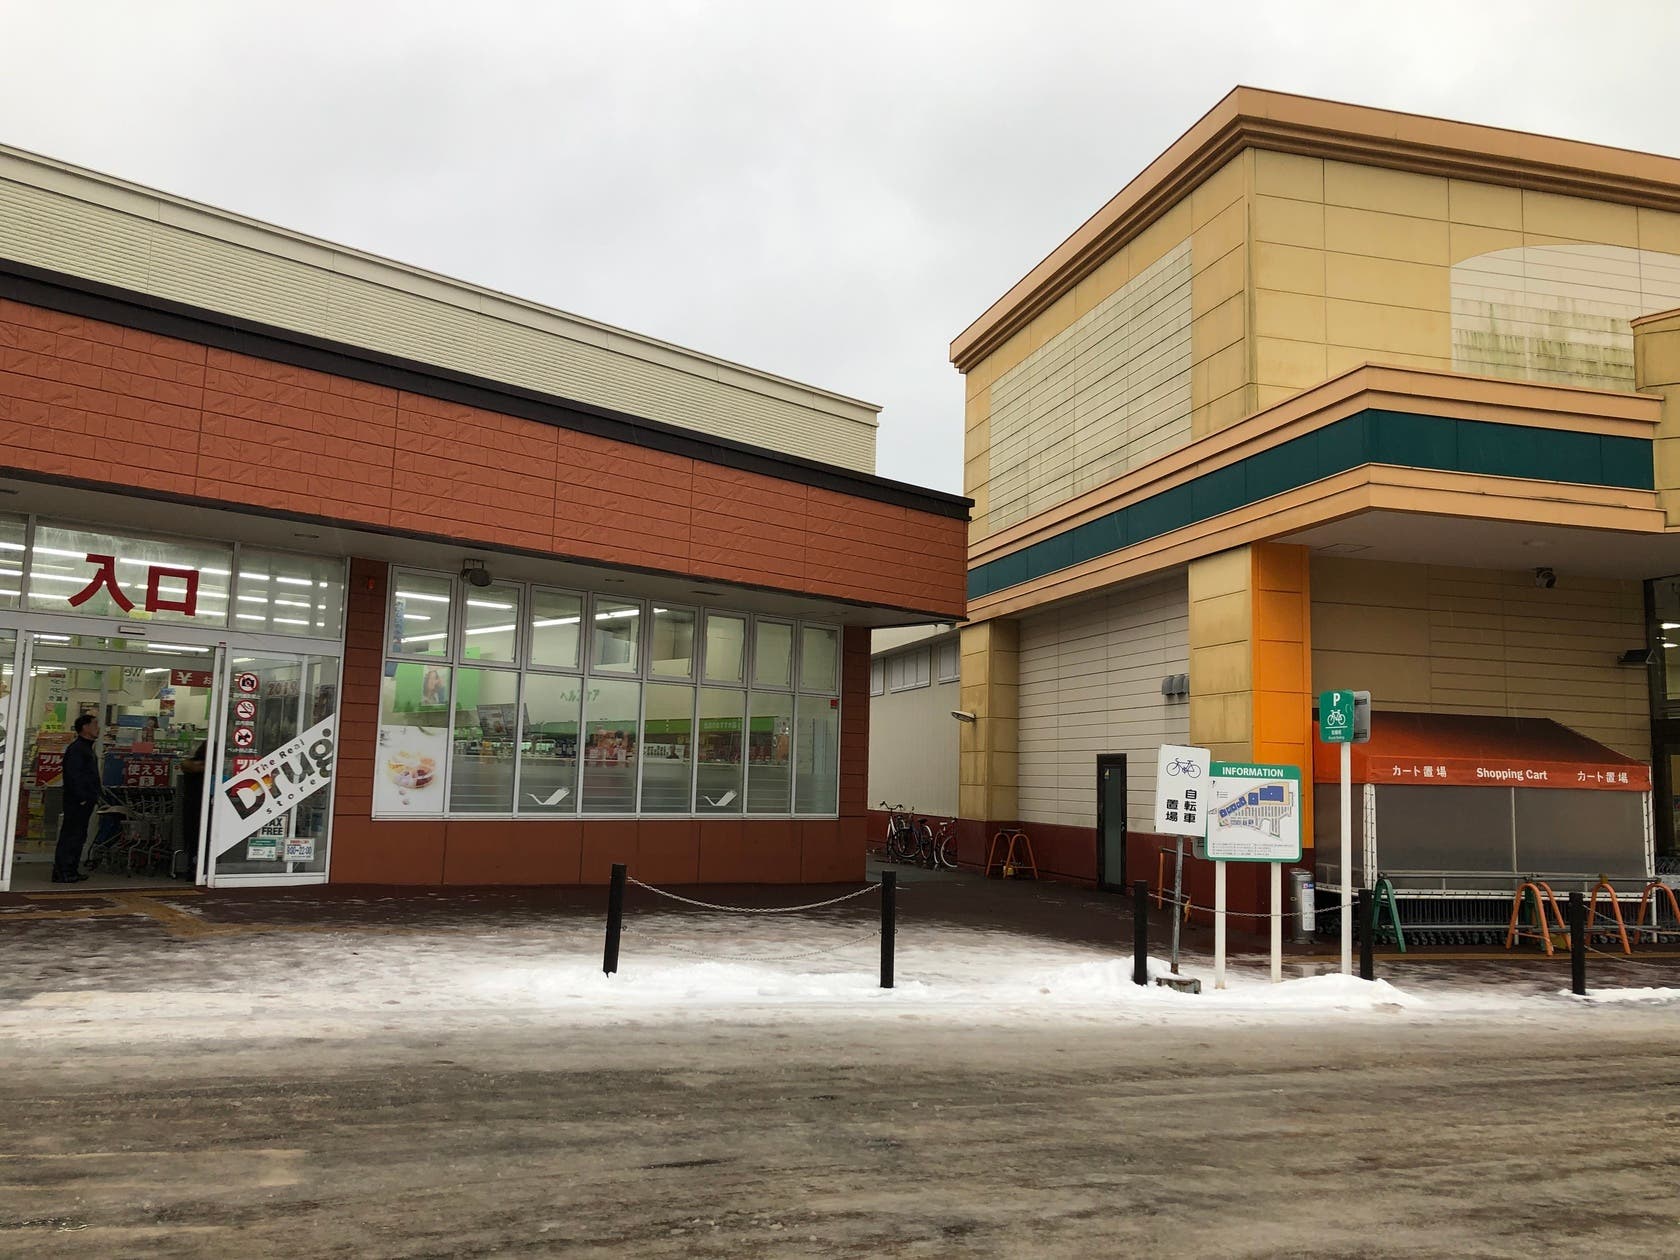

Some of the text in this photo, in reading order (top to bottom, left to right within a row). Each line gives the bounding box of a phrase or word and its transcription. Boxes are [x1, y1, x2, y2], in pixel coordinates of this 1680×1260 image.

[67, 553, 200, 616] 入口
[1333, 692, 1341, 707] P
[254, 757, 276, 775] The
[279, 739, 306, 759] Real
[225, 728, 333, 820] Drug
[1222, 766, 1284, 778] INFORMATION
[1392, 765, 1447, 778] カート置場
[1476, 767, 1548, 781] Shopping Cart
[1577, 771, 1629, 784] カート置場
[266, 778, 316, 815] store
[1183, 788, 1197, 824] 自転車
[1165, 798, 1179, 823] 置場
[262, 827, 284, 836] FREE
